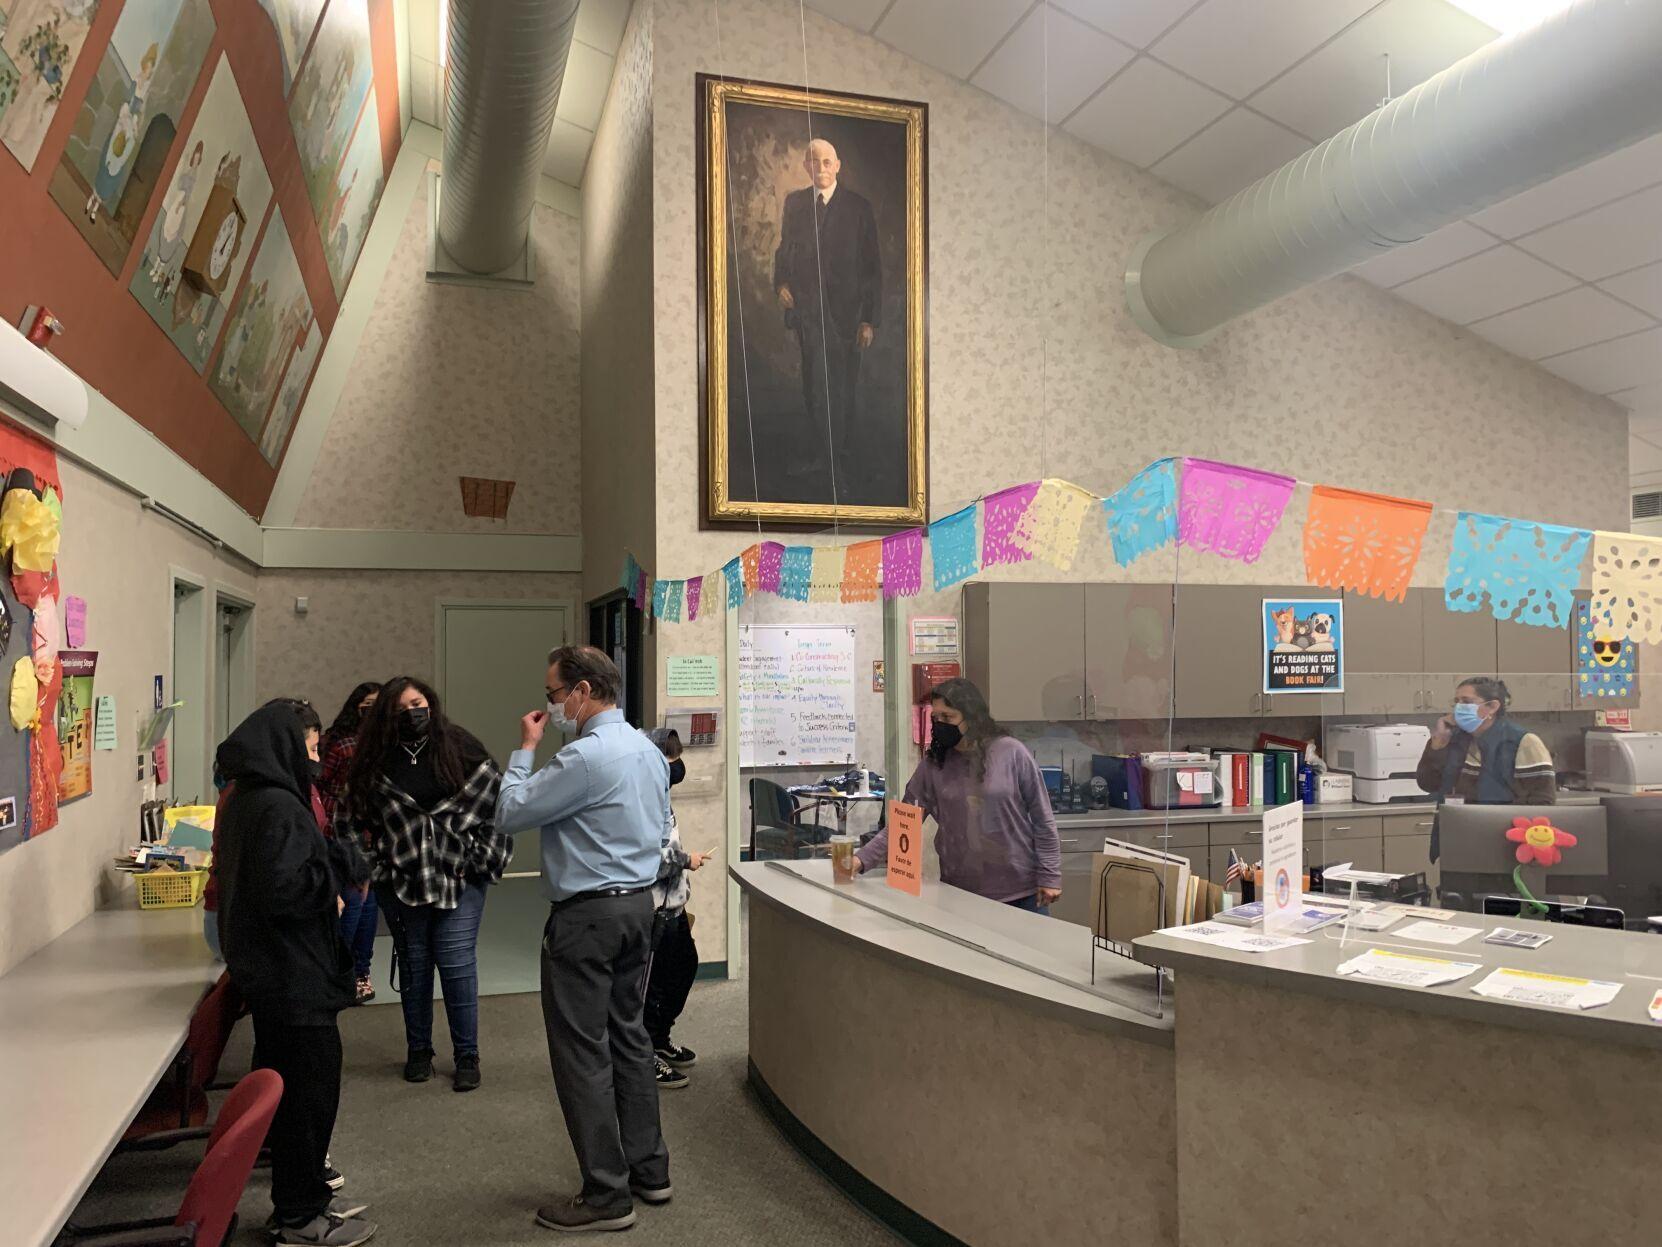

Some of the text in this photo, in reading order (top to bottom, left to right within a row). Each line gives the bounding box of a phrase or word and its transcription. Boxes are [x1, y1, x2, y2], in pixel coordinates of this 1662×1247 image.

[1273, 654, 1336, 663] IT'S READING CATS
[84, 658, 94, 669] Steps
[1273, 666, 1288, 674] AND
[1290, 666, 1308, 674] DOGS
[1321, 665, 1336, 673] THE
[1285, 675, 1324, 685] BOOK FAIR!
[799, 693, 818, 704] Equity
[800, 712, 828, 721] Feedback
[828, 712, 854, 721] connected
[805, 721, 830, 732] Success
[894, 807, 916, 820] Please wait
[900, 821, 910, 830] here.
[895, 855, 906, 864] Favor
